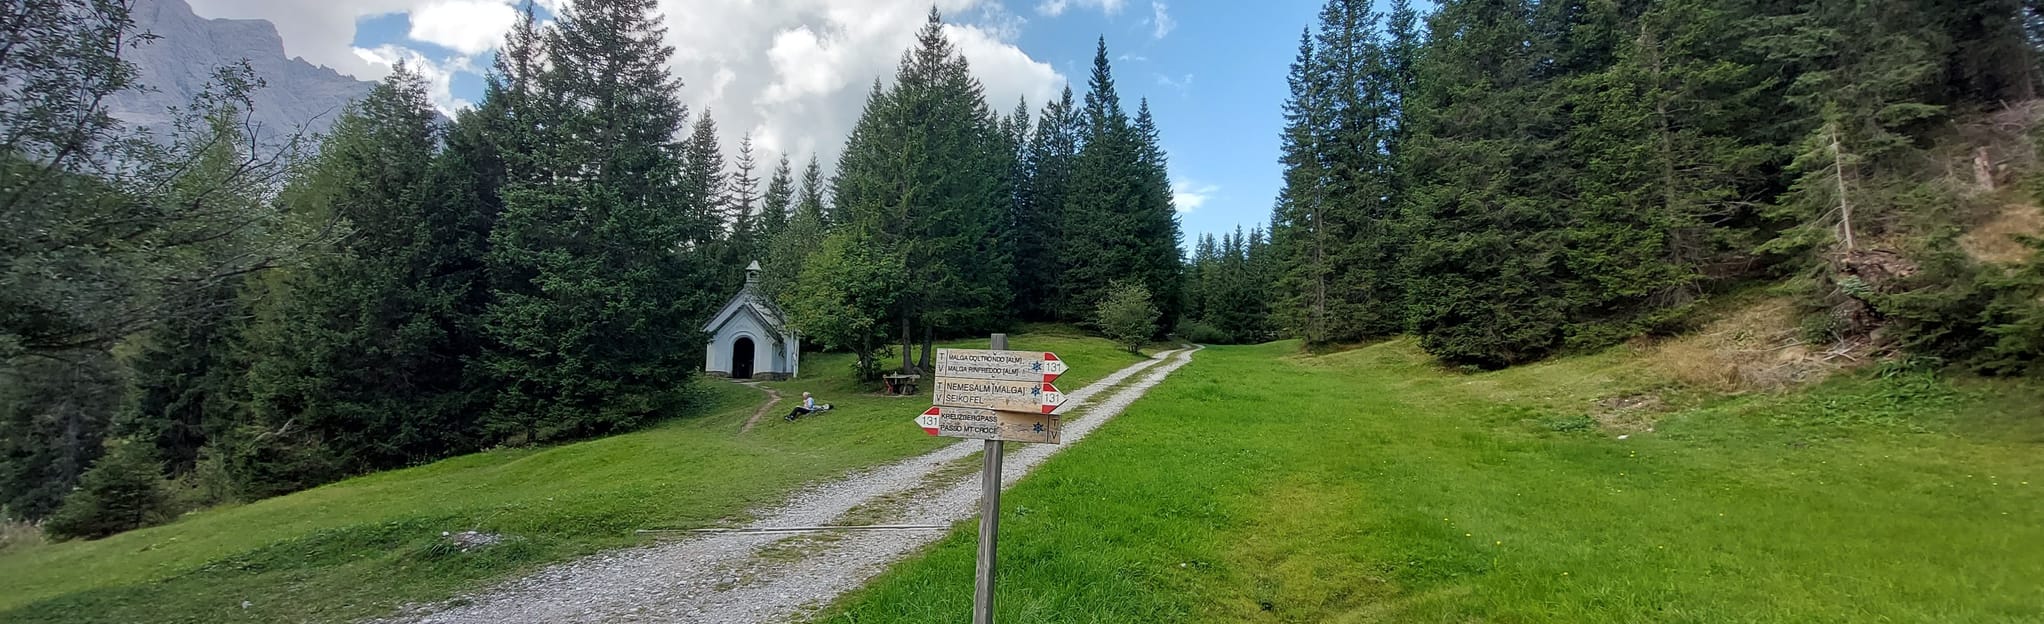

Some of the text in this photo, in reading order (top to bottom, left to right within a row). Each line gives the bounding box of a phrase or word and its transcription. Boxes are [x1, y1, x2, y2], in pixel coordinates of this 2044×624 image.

[1046, 362, 1061, 371] 131
[947, 383, 990, 392] NEMESALM
[1045, 394, 1059, 403] 131
[922, 416, 937, 425] 131
[941, 413, 997, 422] KREUZBERGPASS
